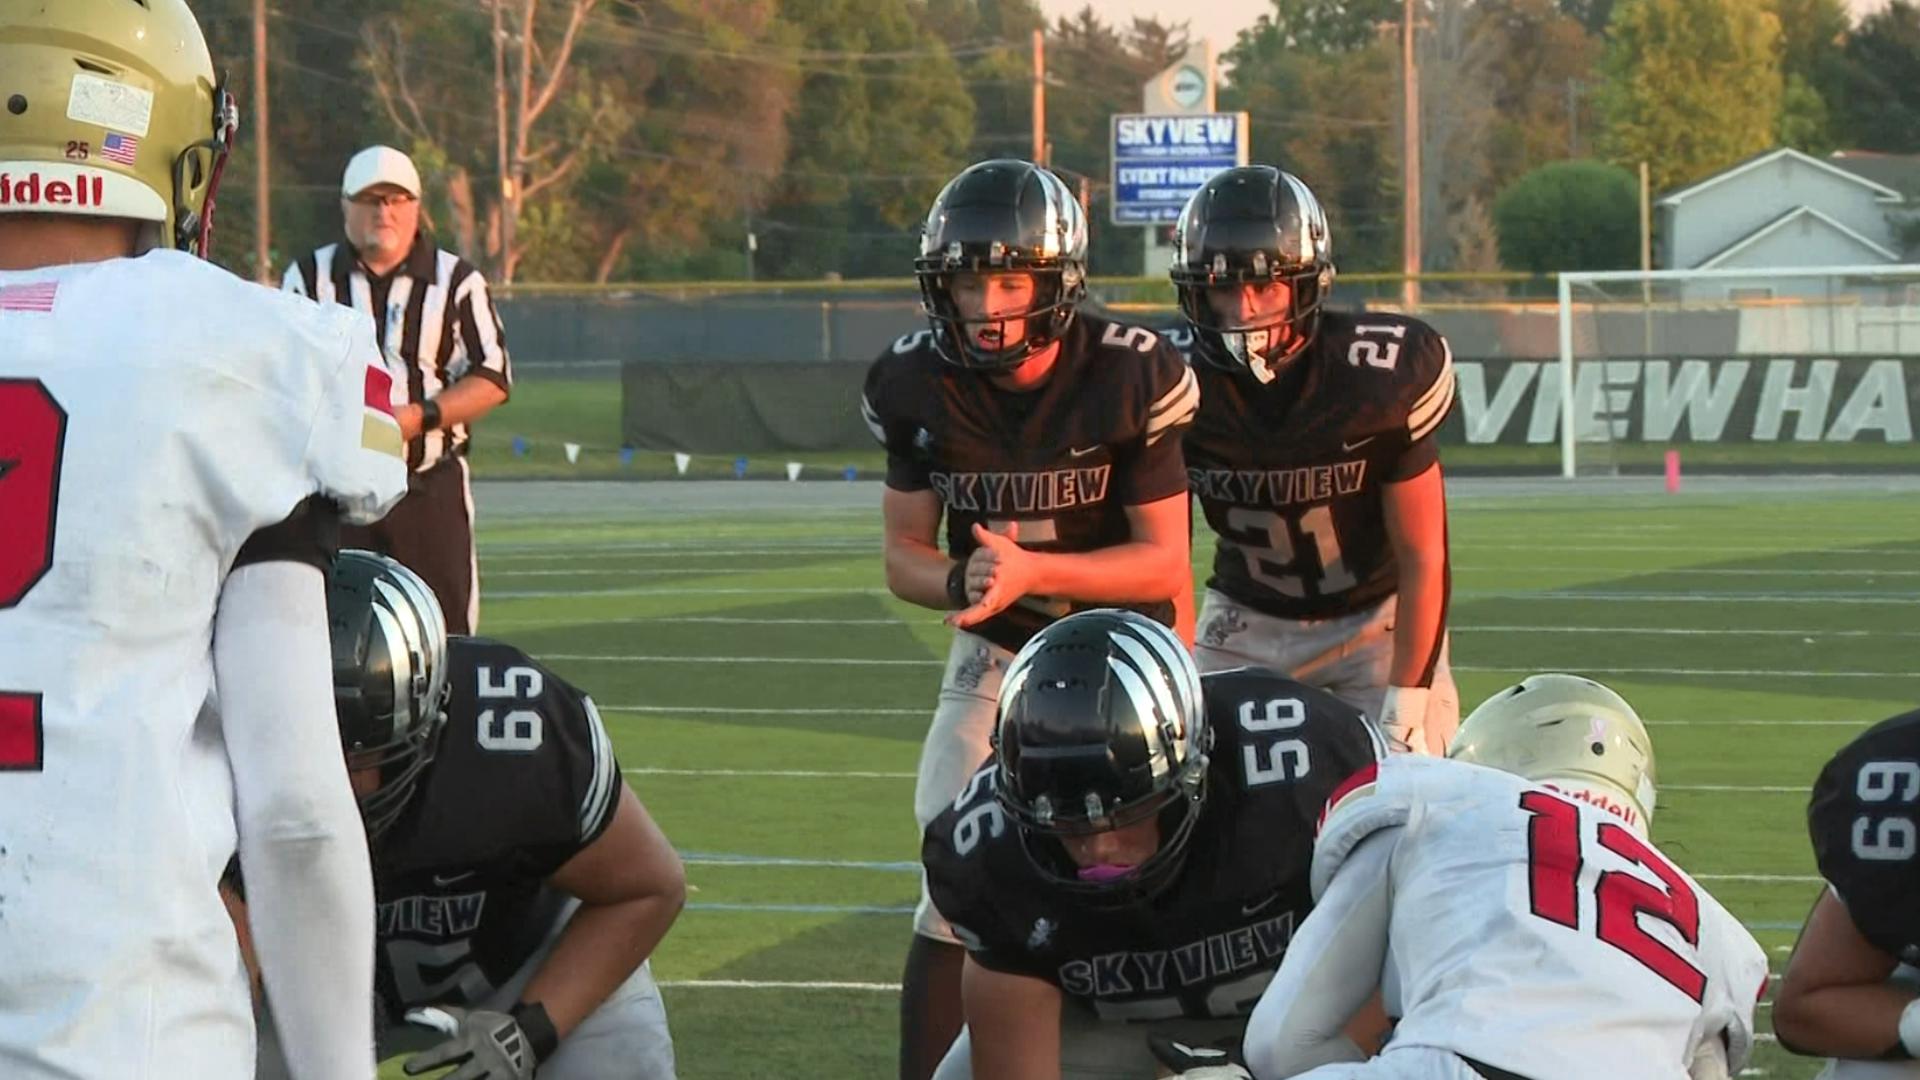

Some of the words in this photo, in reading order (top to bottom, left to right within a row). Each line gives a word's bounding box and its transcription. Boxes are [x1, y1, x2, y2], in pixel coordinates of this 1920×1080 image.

[65, 140, 90, 160] 25
[1118, 118, 1233, 145] SKYVIEW
[1102, 322, 1157, 352] 5
[1348, 324, 1408, 370] 21
[1752, 361, 1912, 442] HA
[929, 464, 1111, 512] SKYVIEW
[1226, 505, 1359, 598] 21
[477, 665, 544, 752] 65
[1239, 697, 1311, 789] 56
[953, 763, 1005, 856] 56
[1851, 761, 1920, 860] 69
[1519, 790, 1708, 1005] 12
[1058, 911, 1294, 995] SKYVIEW
